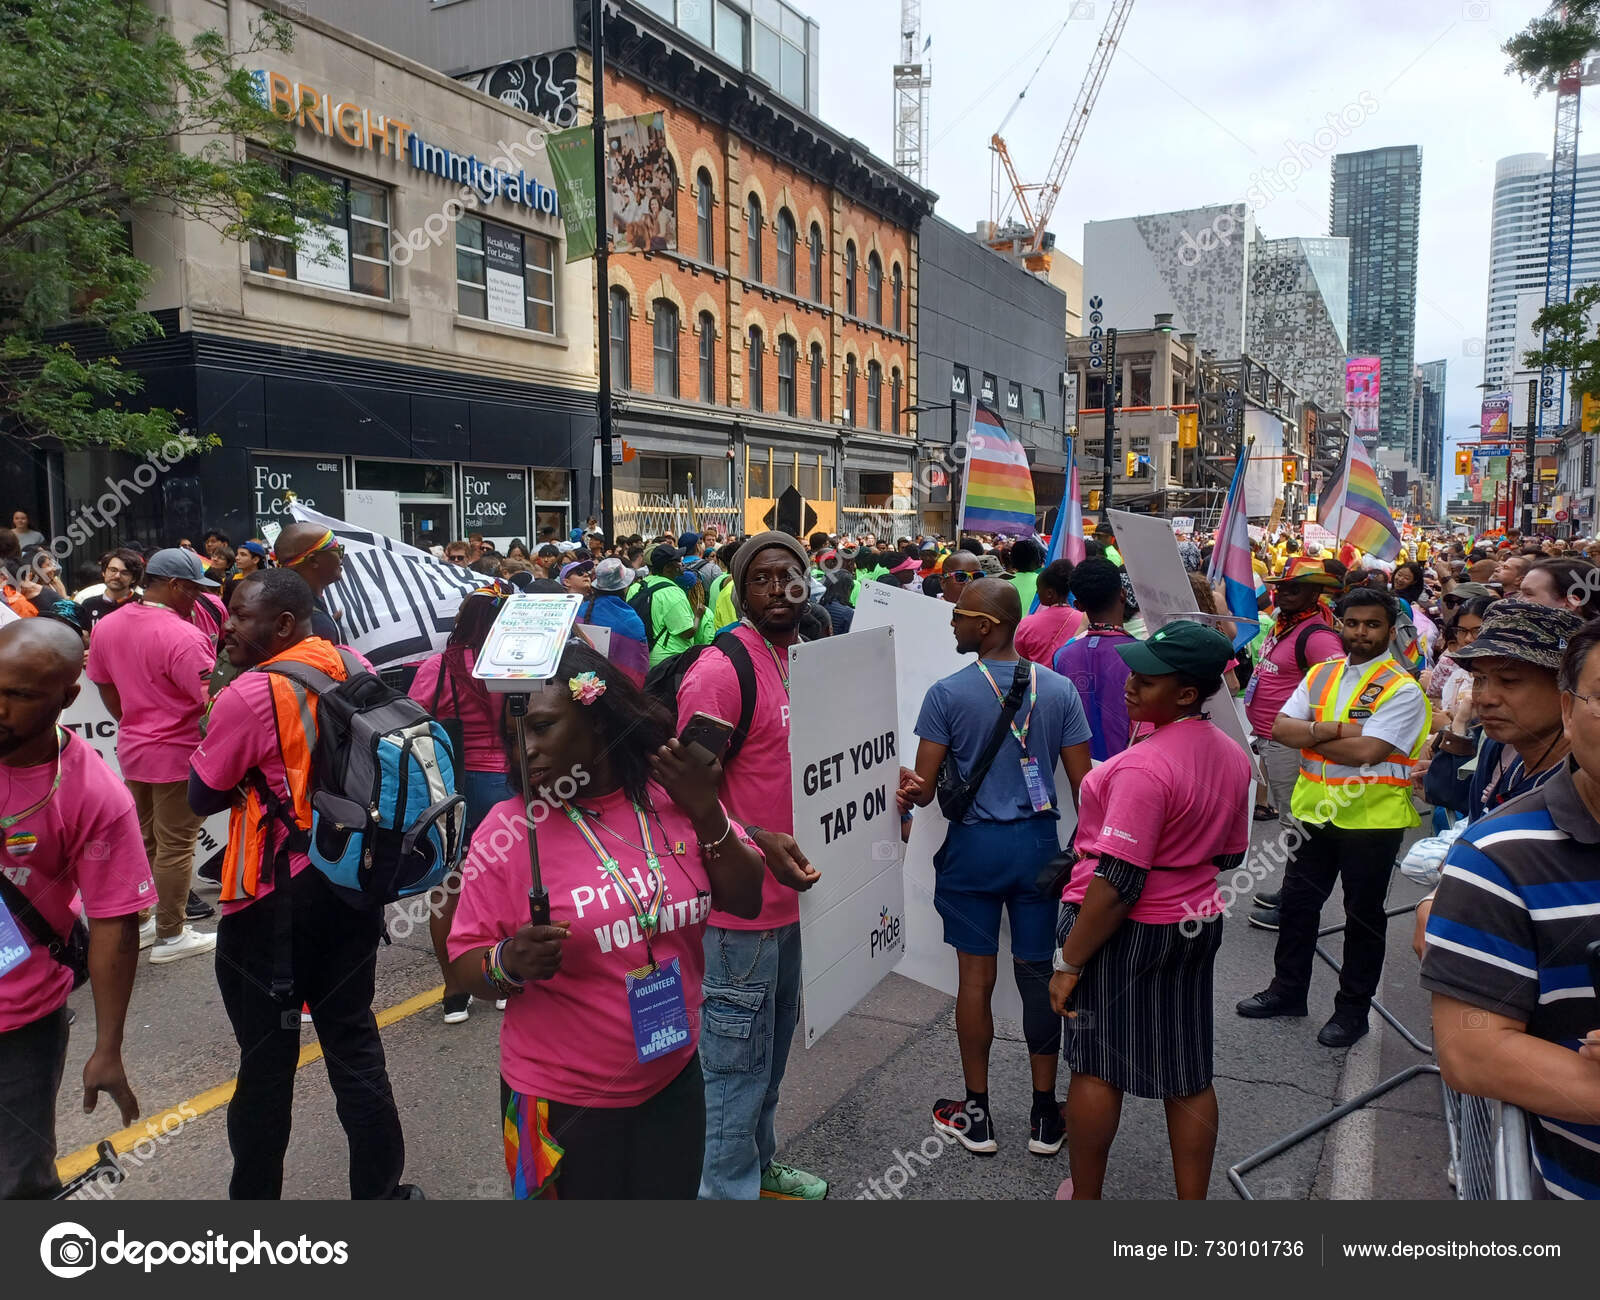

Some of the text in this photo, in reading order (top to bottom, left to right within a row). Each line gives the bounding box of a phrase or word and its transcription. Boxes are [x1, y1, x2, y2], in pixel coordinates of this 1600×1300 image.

[268, 71, 412, 161] BRIGHT
[487, 246, 514, 261] For Lease
[1089, 295, 1104, 369] Yonge
[1106, 331, 1115, 385] DOWNTOWN
[1541, 365, 1555, 408] onge
[254, 466, 292, 490] For
[464, 475, 491, 495] For
[465, 496, 507, 516] Lease
[465, 518, 482, 527] Retail
[803, 730, 896, 796] GET YOUR
[820, 784, 886, 845] TAP ON
[0, 866, 31, 887] ER
[571, 866, 669, 919] Pride
[594, 893, 712, 953] VOLNTEE
[870, 907, 900, 958] Pride
[635, 976, 676, 998] VOLUNTEER
[641, 1031, 688, 1056] WKND
[650, 1025, 677, 1043] ALL
